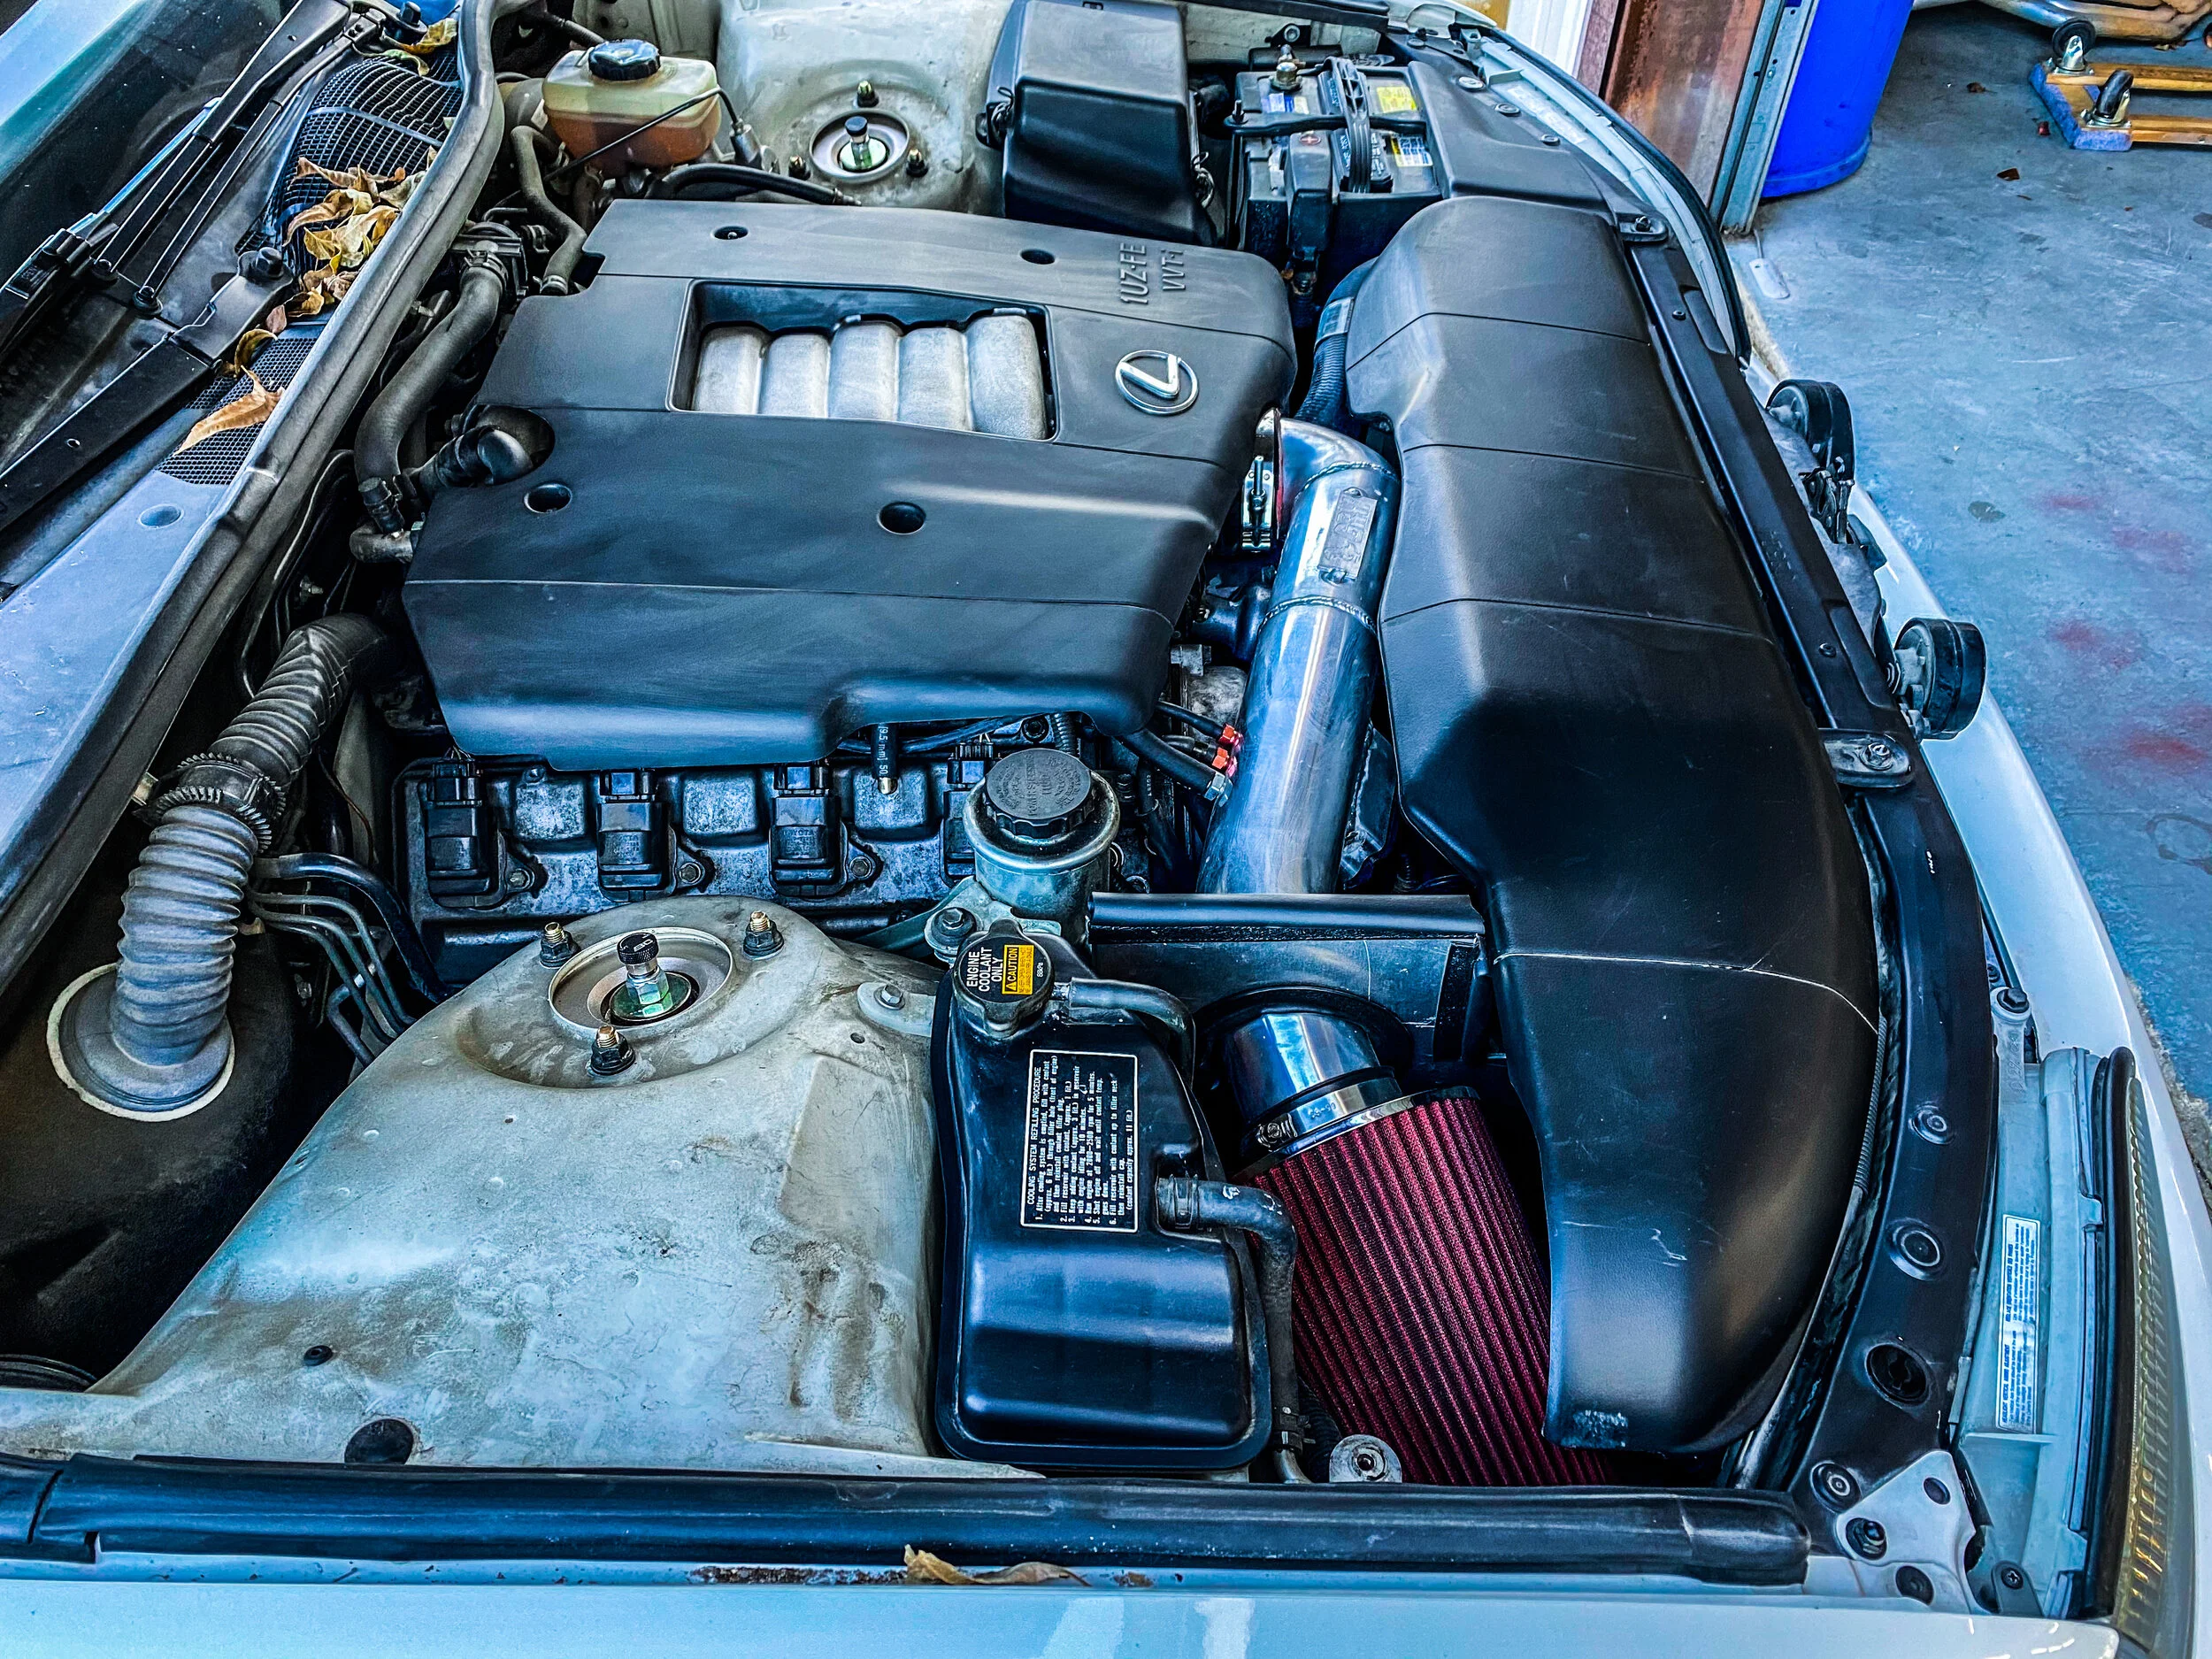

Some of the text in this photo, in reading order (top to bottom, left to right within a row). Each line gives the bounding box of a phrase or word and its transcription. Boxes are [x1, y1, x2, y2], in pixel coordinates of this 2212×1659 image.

[877, 744, 888, 761] mm]
[966, 951, 979, 987] ENGINE
[979, 947, 992, 992] COOLANT
[991, 957, 1003, 982] ONLY
[1008, 948, 1018, 981] CAUTION
[1027, 1176, 1036, 1204] COOLING
